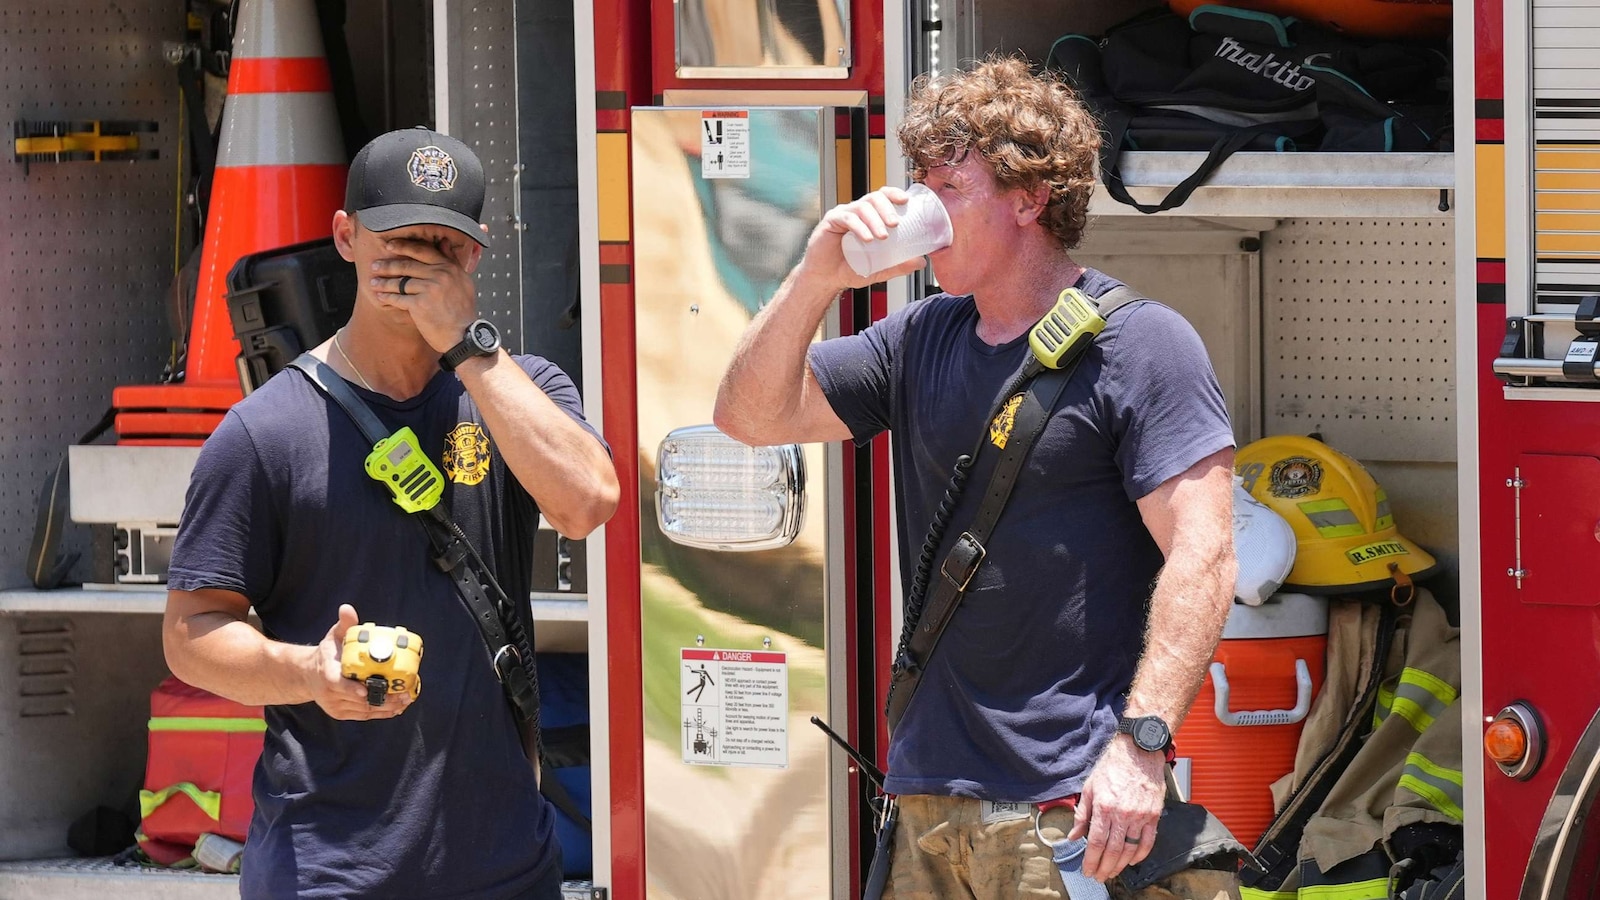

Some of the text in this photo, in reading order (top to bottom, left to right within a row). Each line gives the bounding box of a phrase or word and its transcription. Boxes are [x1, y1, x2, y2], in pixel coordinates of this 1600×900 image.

[452, 426, 476, 440] AUSTIN
[462, 471, 482, 482] FIRE
[1352, 543, 1406, 562] R.SMITH
[722, 652, 752, 661] DANGER
